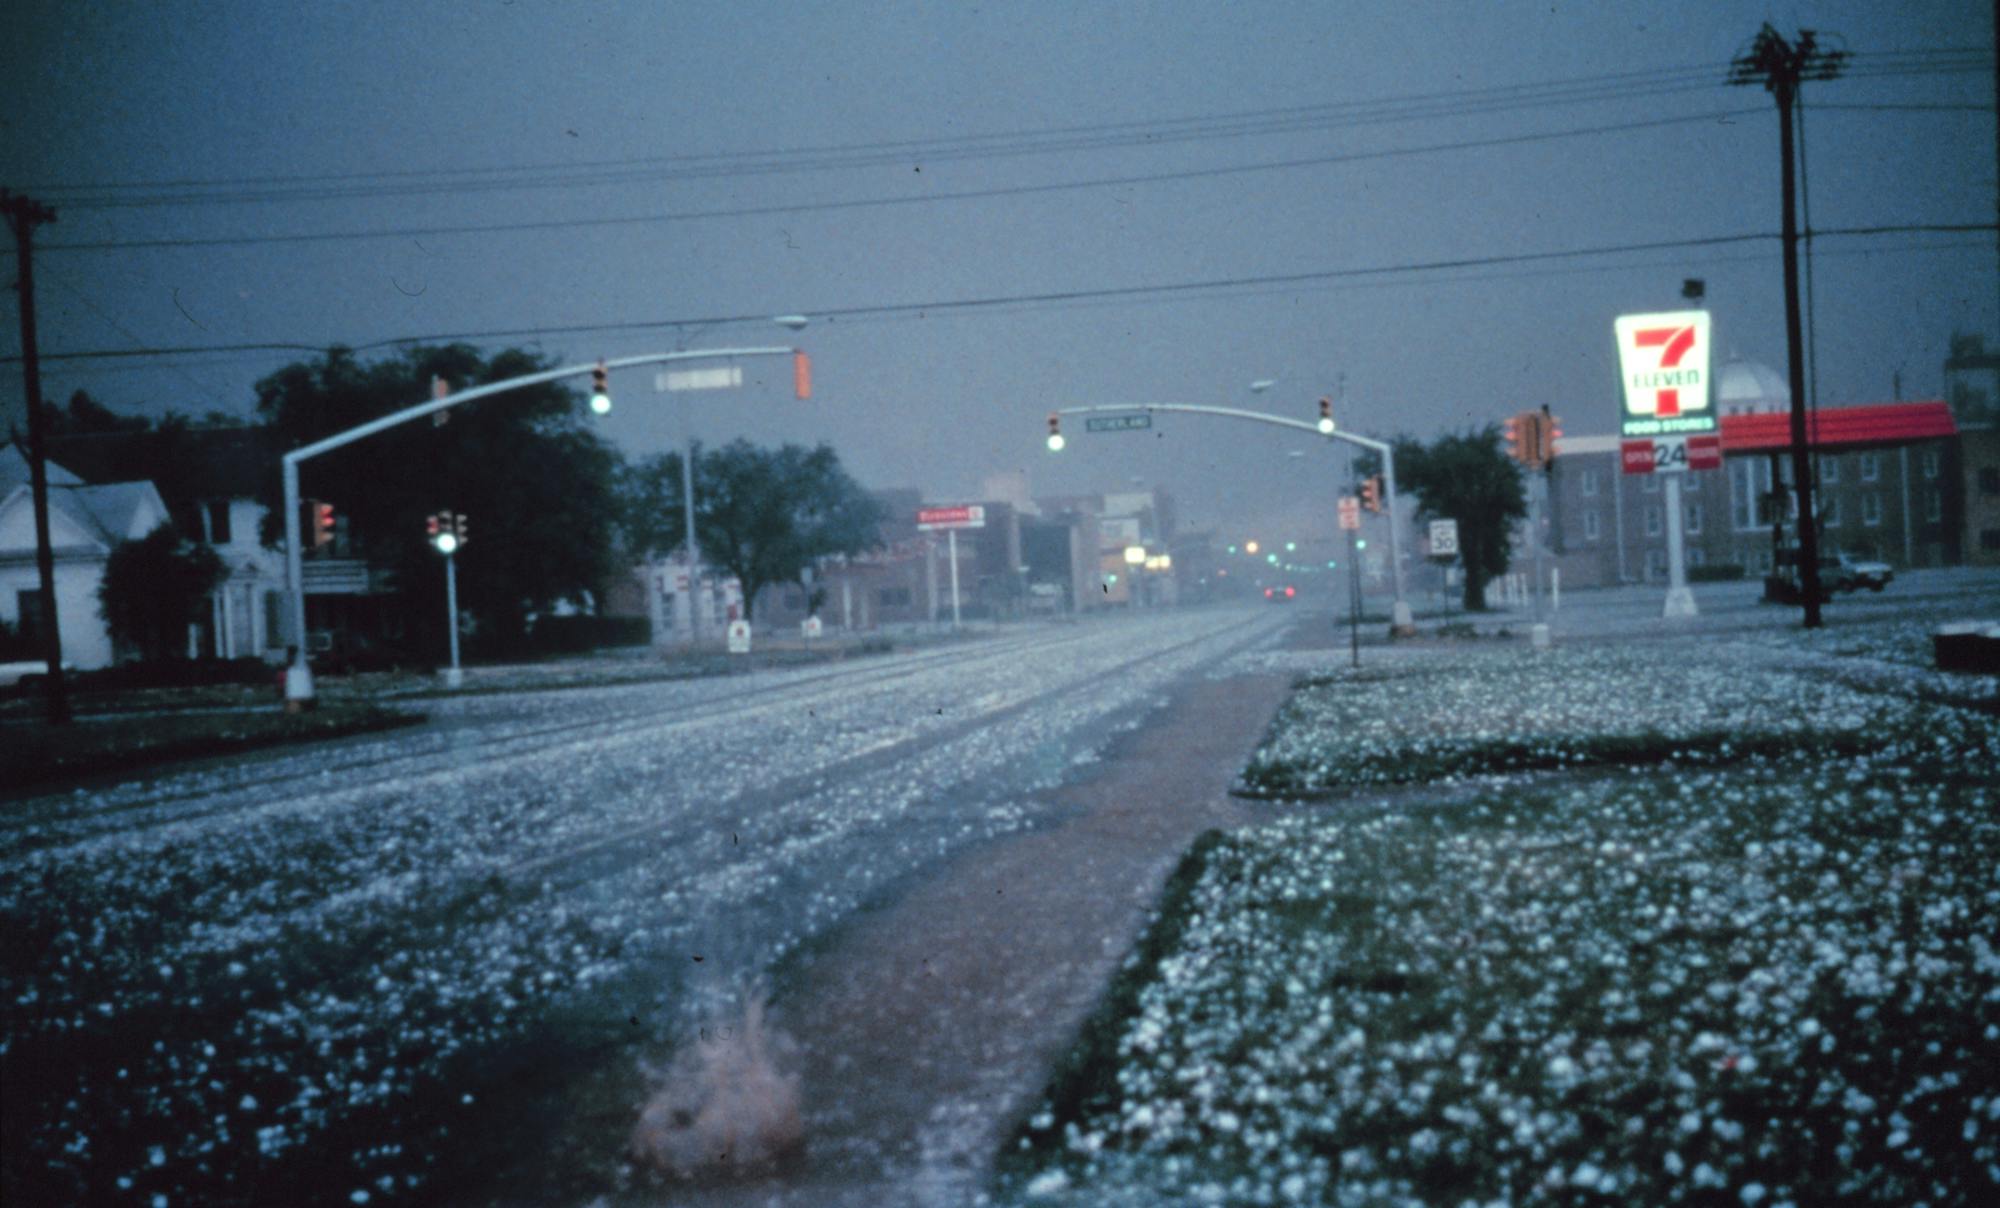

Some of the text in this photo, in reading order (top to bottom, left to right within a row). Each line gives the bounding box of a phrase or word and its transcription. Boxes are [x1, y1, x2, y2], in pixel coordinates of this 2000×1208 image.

[1623, 416, 1714, 434] FOOD STORES
[1655, 443, 1686, 466] 24
[1433, 536, 1455, 550] 30
